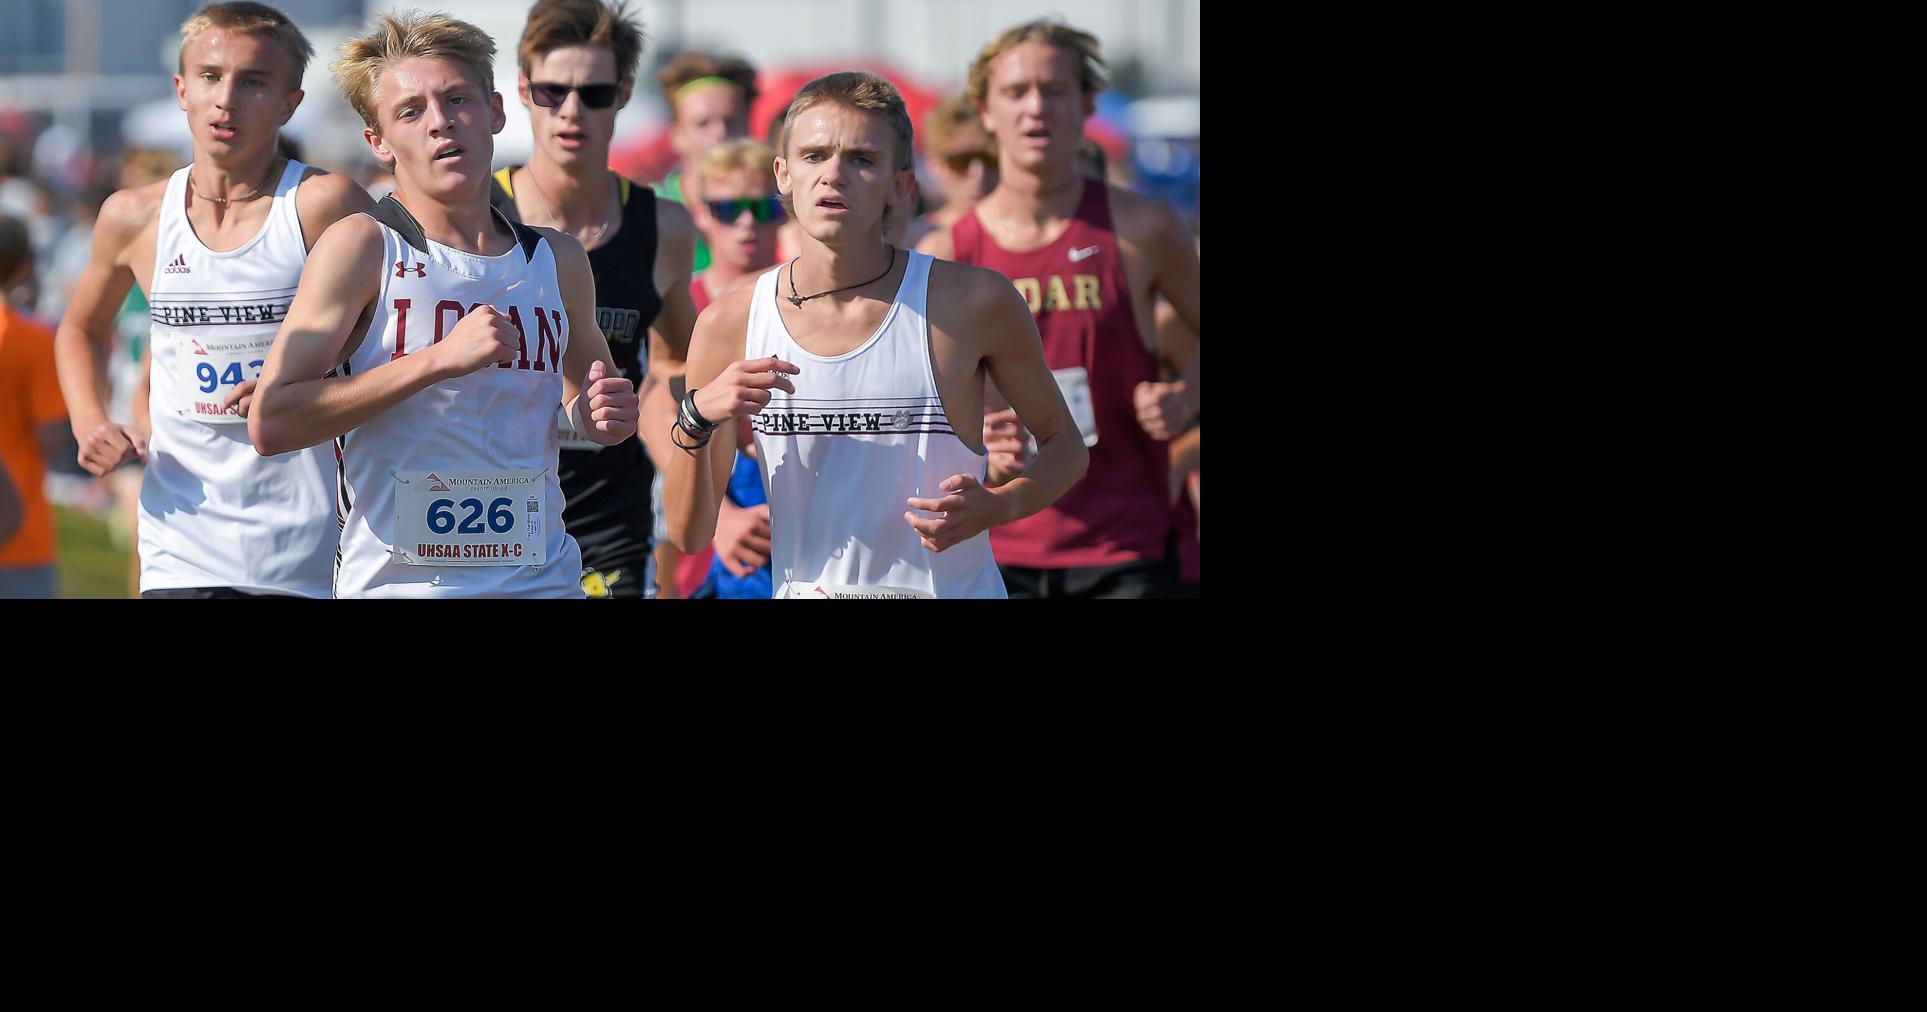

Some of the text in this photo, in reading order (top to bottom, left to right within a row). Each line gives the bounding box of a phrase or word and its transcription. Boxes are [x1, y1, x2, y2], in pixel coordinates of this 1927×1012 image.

[164, 266, 191, 274] adidas
[1012, 274, 1101, 314] DAR
[163, 304, 274, 325] PINE VIEW
[596, 306, 640, 342] OOD
[391, 299, 562, 373] LOAN
[762, 413, 881, 431] PINE VIEW
[448, 477, 529, 486] MOUNTAIN AMERICA
[426, 497, 515, 534] 626
[418, 543, 522, 558] UHSAA STATE X-C
